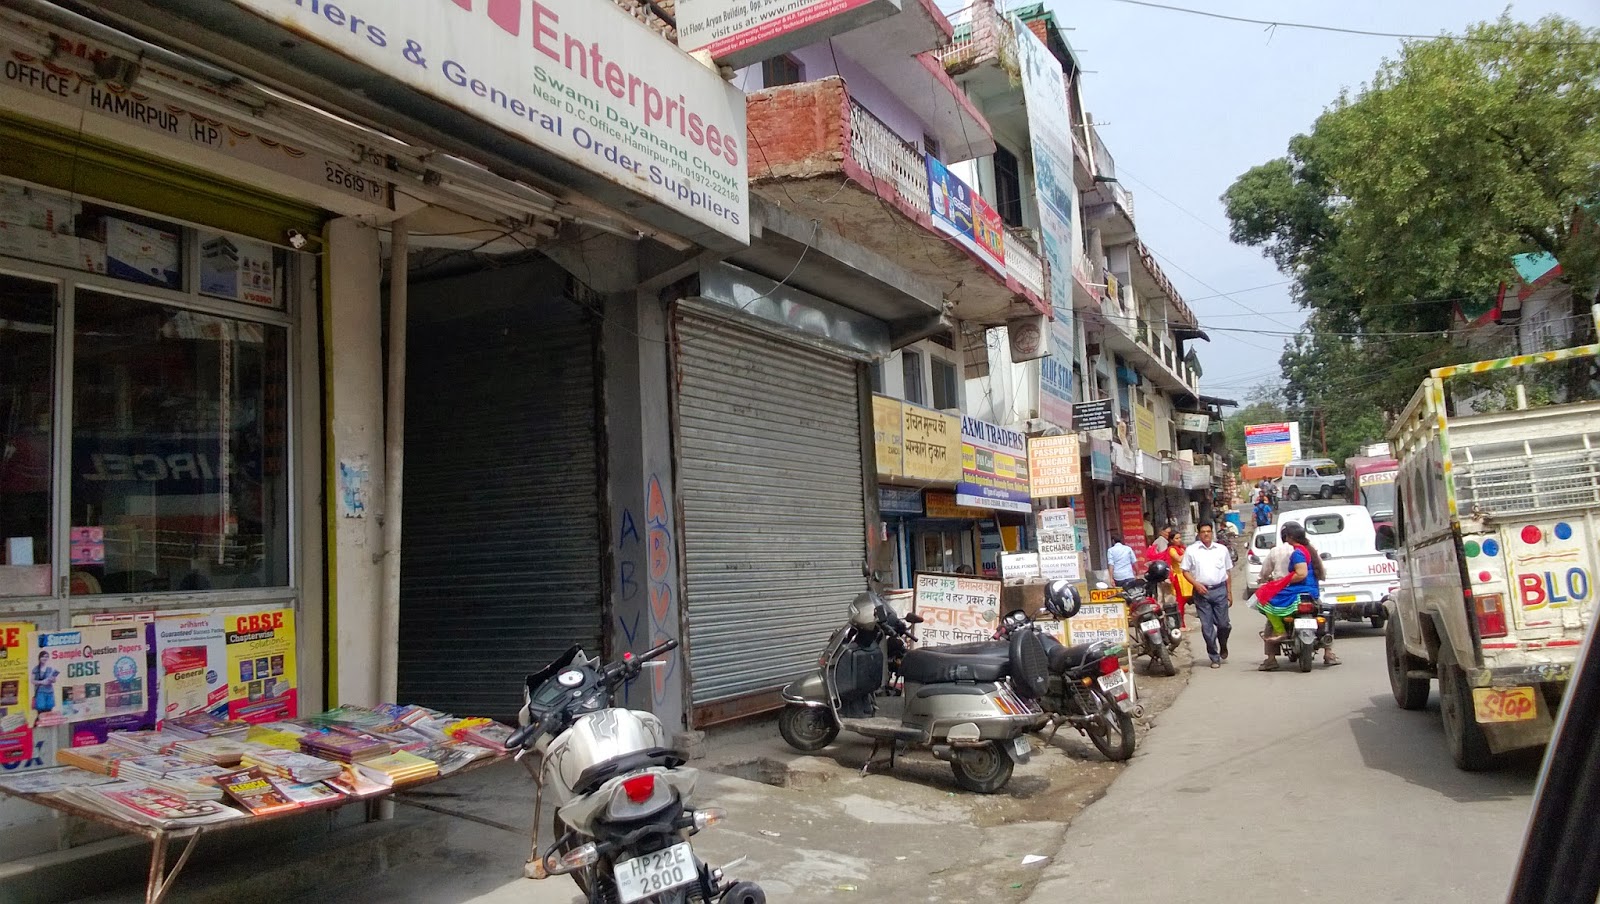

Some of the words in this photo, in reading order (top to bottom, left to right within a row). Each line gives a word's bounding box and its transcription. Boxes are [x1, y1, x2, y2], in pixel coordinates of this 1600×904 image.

[706, 15, 722, 28] Aryan
[711, 26, 730, 39] visit
[733, 23, 743, 31] us
[745, 17, 757, 27] at:
[532, 1, 739, 167] Enterprises
[5, 60, 69, 97] OFFICE
[91, 87, 179, 133] HAMIRPUR
[533, 84, 562, 108] Near
[402, 39, 428, 69] &
[442, 60, 563, 137] General
[572, 126, 642, 174] Order
[649, 165, 740, 225] Suppliers
[534, 65, 600, 113] Swami
[606, 105, 688, 161] Dayanand
[693, 156, 740, 190] Chowk
[325, 167, 365, 192] 25619
[1041, 356, 1057, 382] BLUE
[961, 415, 984, 440] AXMI
[985, 424, 1024, 451] TRADERS
[1031, 436, 1076, 448] AFFIDAVITS
[1034, 446, 1074, 457] PASSPORT
[1037, 456, 1073, 467] PANCARD
[1040, 467, 1071, 476] LICENSE
[1034, 476, 1079, 486] PHOTOSTAT
[1041, 543, 1074, 553] RECHARGE
[1368, 562, 1396, 574] HORN
[236, 612, 284, 635] CBSE
[229, 631, 275, 643] Chapterwise
[51, 648, 82, 660] Sample
[83, 645, 118, 659] Question
[118, 643, 143, 654] Papers
[67, 660, 101, 678] CBSE
[174, 668, 204, 681] General
[228, 779, 269, 792] CLERICAL
[630, 846, 686, 877] HP22E
[640, 866, 684, 894] 2800
